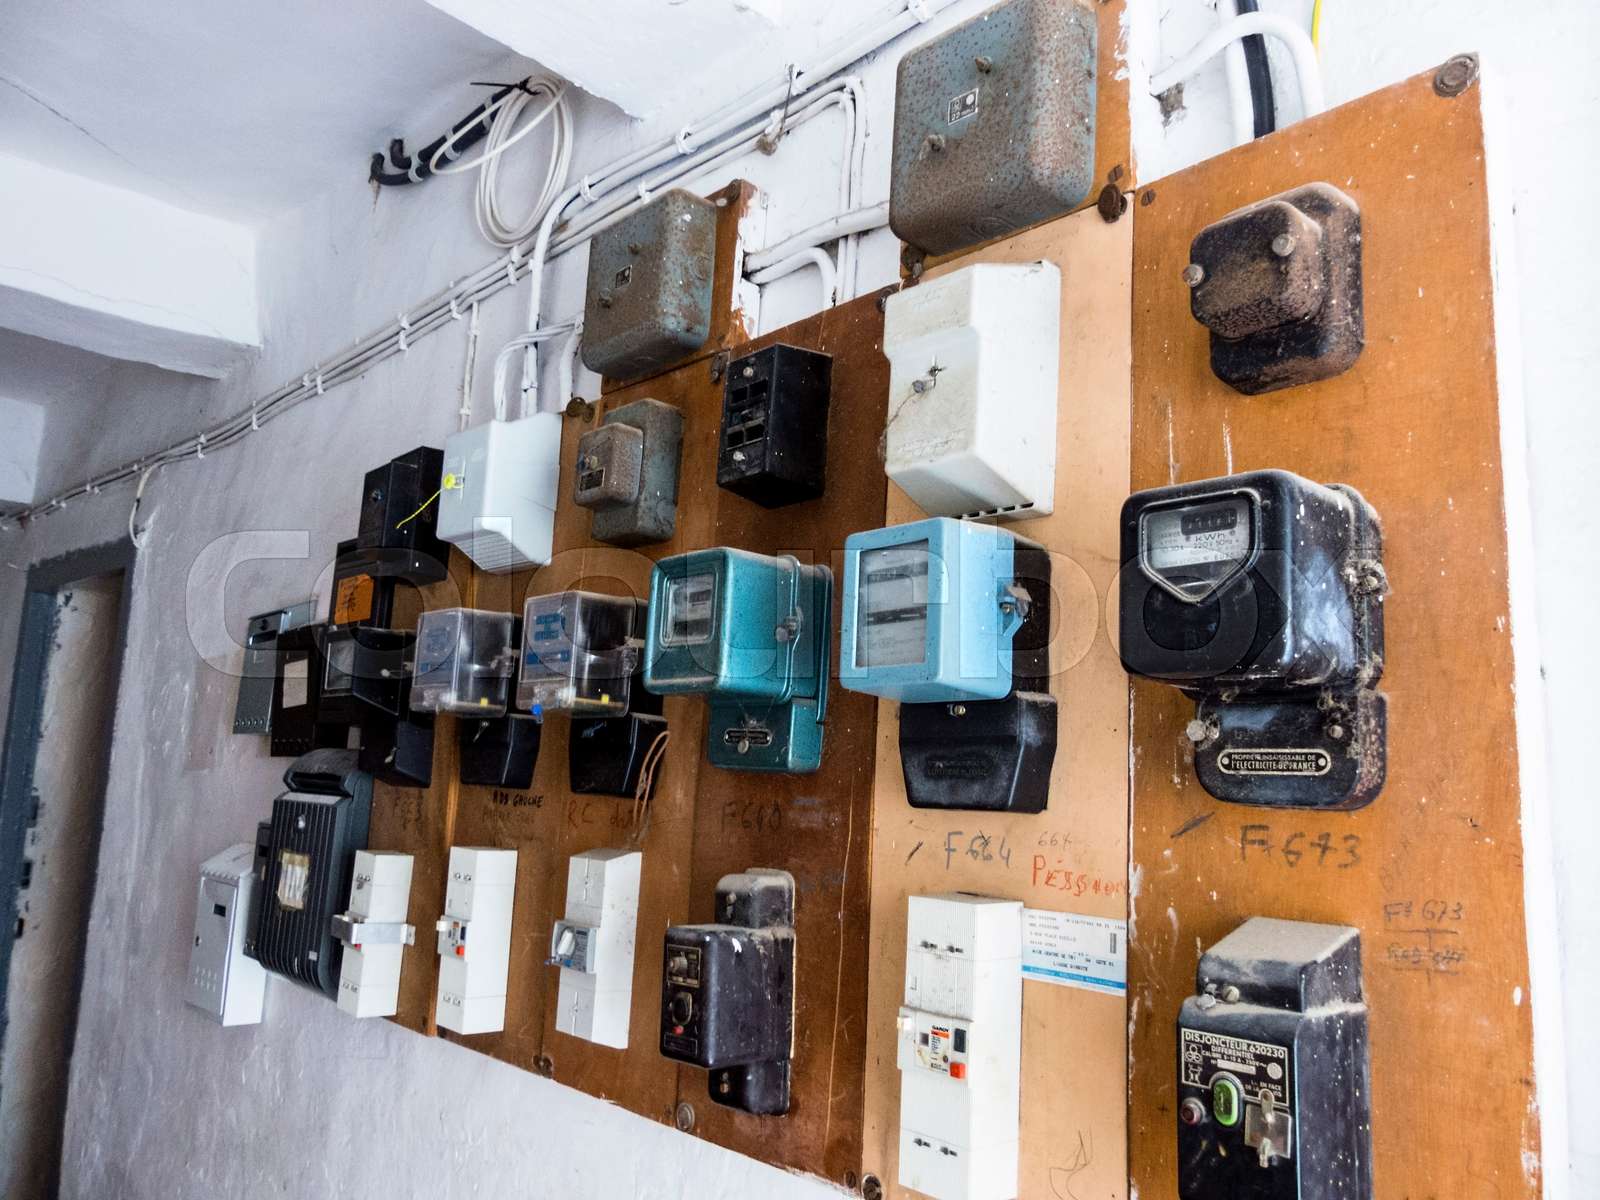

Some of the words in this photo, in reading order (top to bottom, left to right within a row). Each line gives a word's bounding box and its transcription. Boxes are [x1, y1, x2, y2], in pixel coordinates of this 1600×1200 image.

[1194, 531, 1225, 543] kWh
[1185, 1032, 1248, 1051] DISJONCTEUR
[1249, 1044, 1284, 1058] 620230
